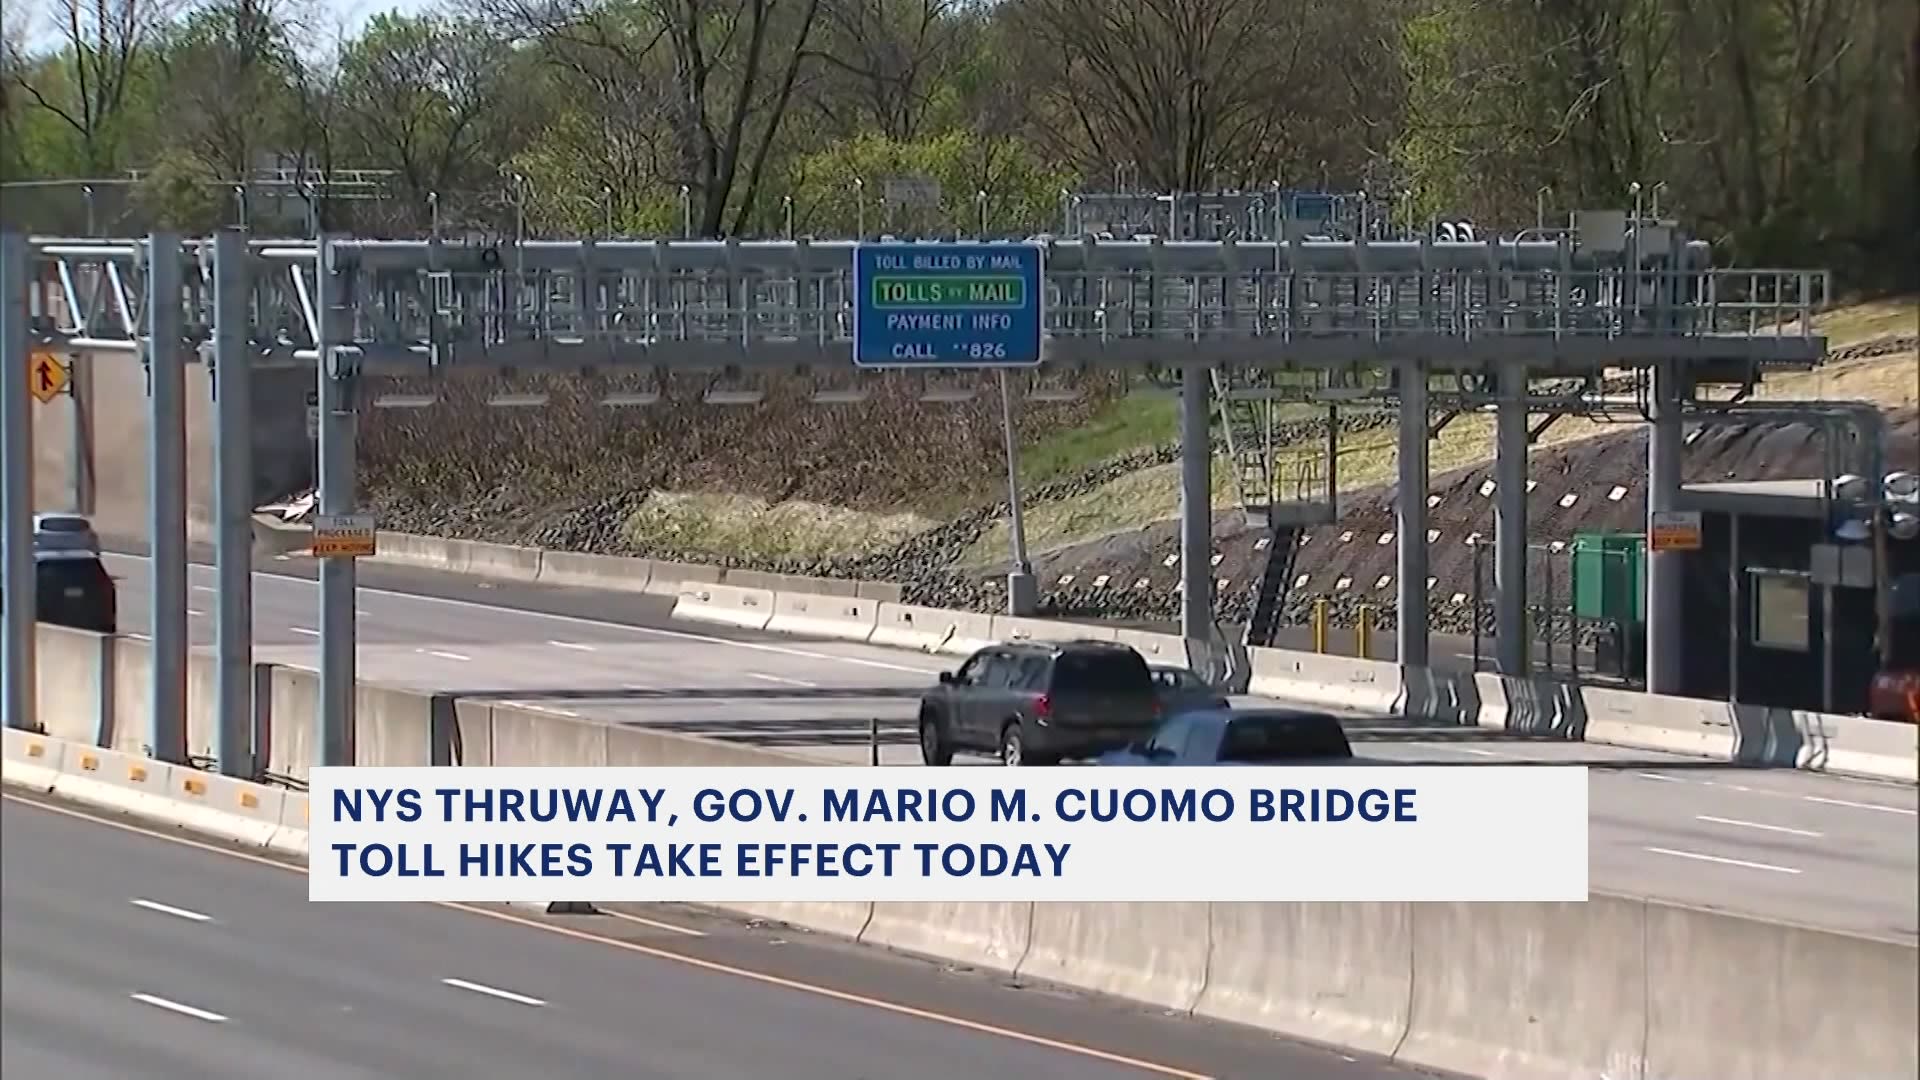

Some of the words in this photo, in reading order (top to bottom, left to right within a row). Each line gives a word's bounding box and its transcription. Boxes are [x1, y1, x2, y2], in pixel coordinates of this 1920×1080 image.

[875, 255, 907, 269] TOLL
[913, 255, 960, 269] BILLED
[966, 255, 985, 269] BY
[990, 255, 1023, 269] MAIL
[881, 283, 942, 301] TOLLS
[969, 283, 1016, 301] MAIL
[887, 314, 963, 329] PAYMENT
[972, 314, 1011, 329] INFO
[892, 343, 936, 359] CALL
